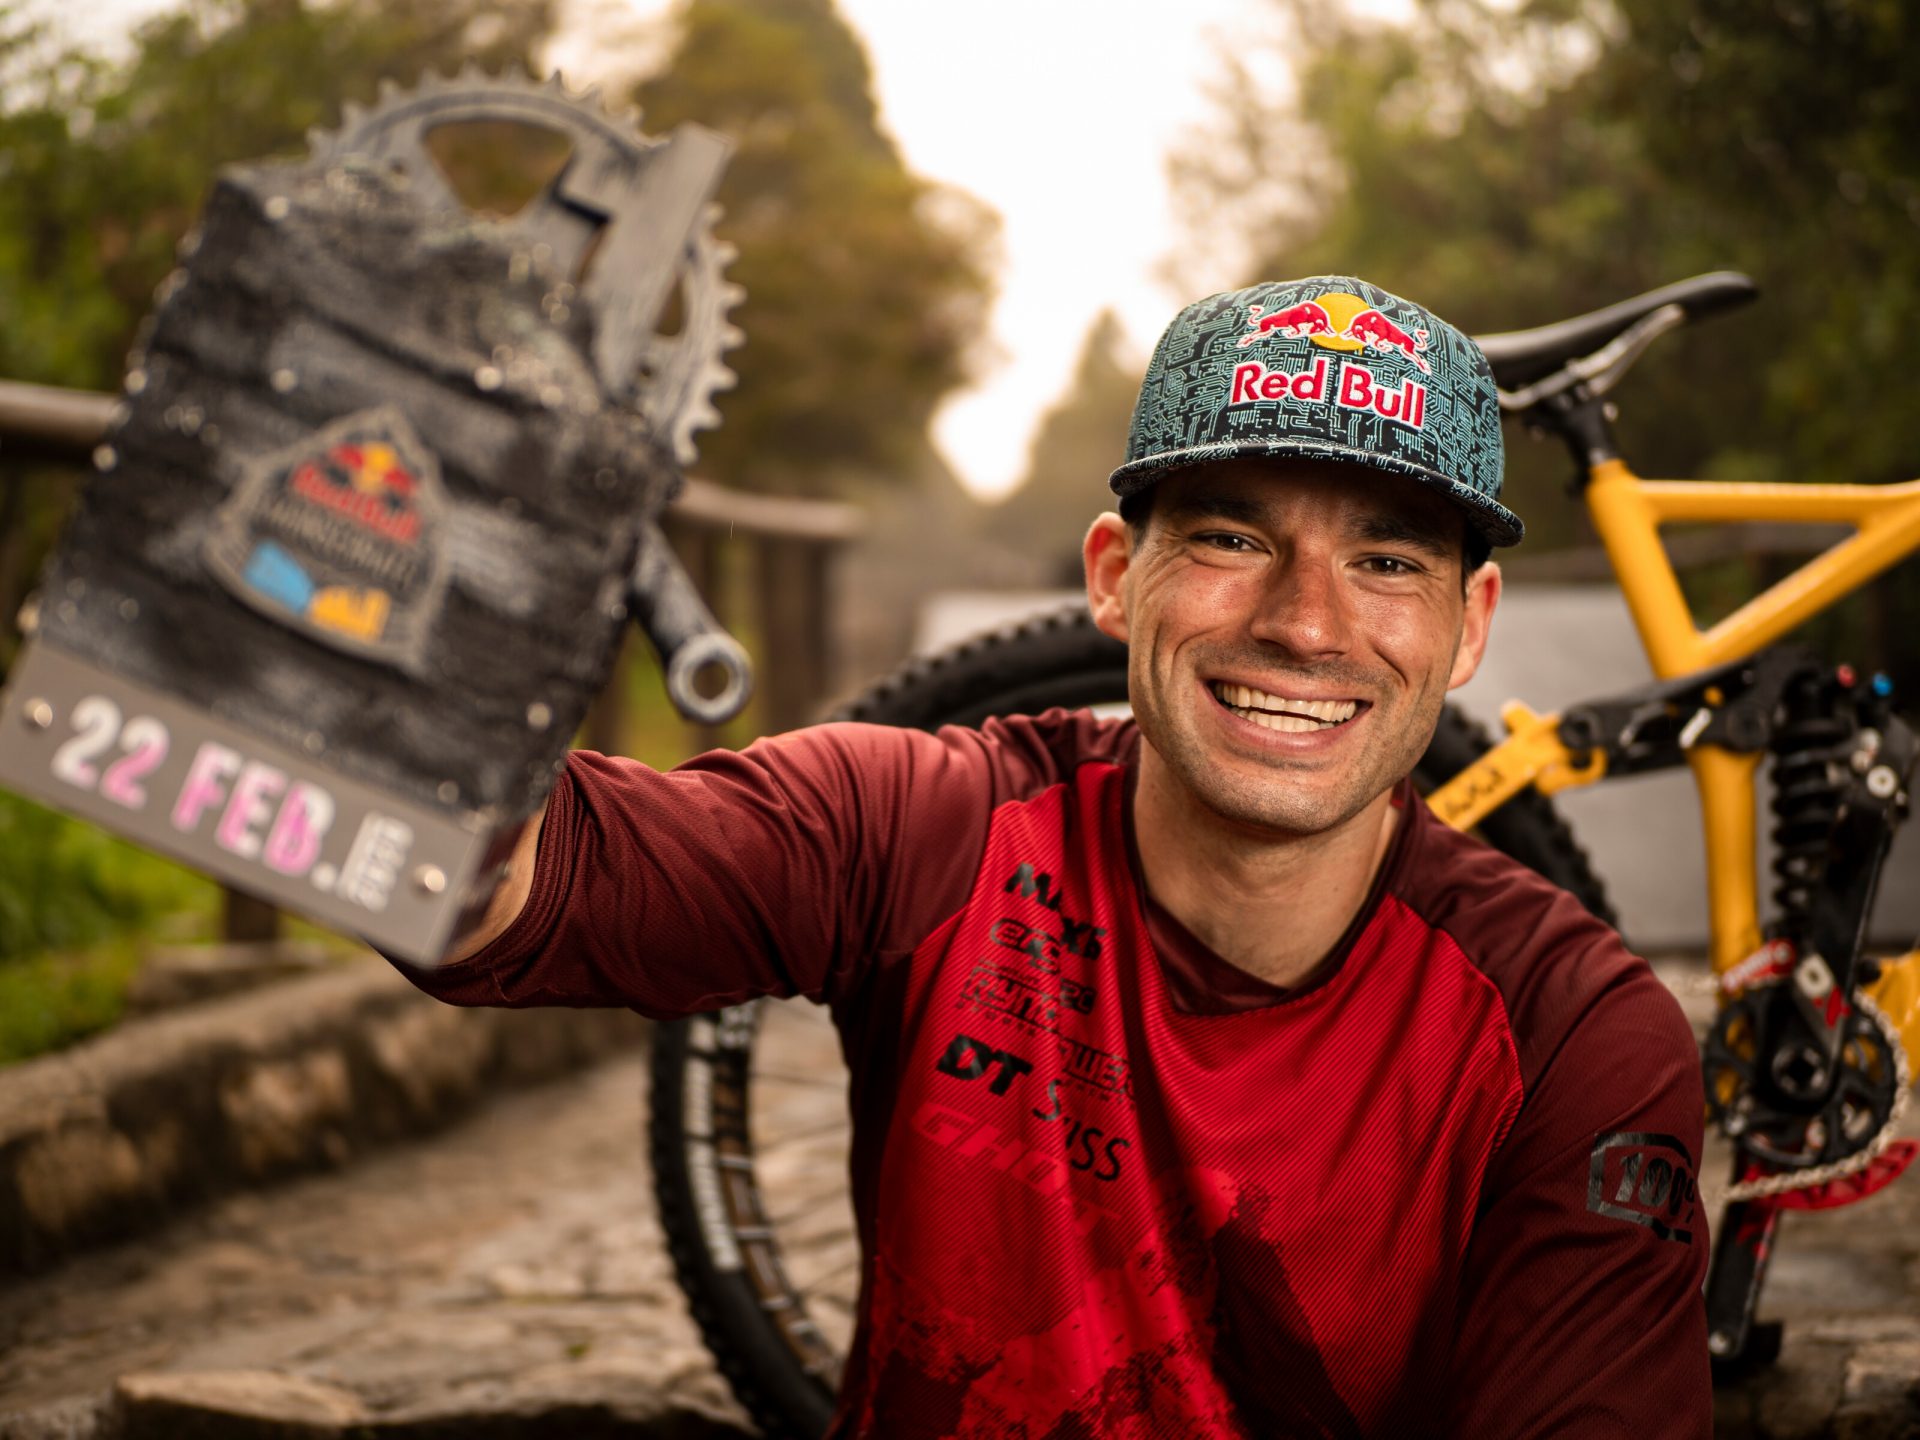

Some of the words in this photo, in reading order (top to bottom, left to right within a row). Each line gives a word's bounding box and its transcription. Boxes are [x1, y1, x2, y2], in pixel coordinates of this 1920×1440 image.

[1230, 358, 1328, 404] Red
[1337, 363, 1427, 428] Bull
[50, 695, 170, 811] 22
[936, 1033, 1033, 1097] DT
[1032, 1079, 1130, 1181] SISS
